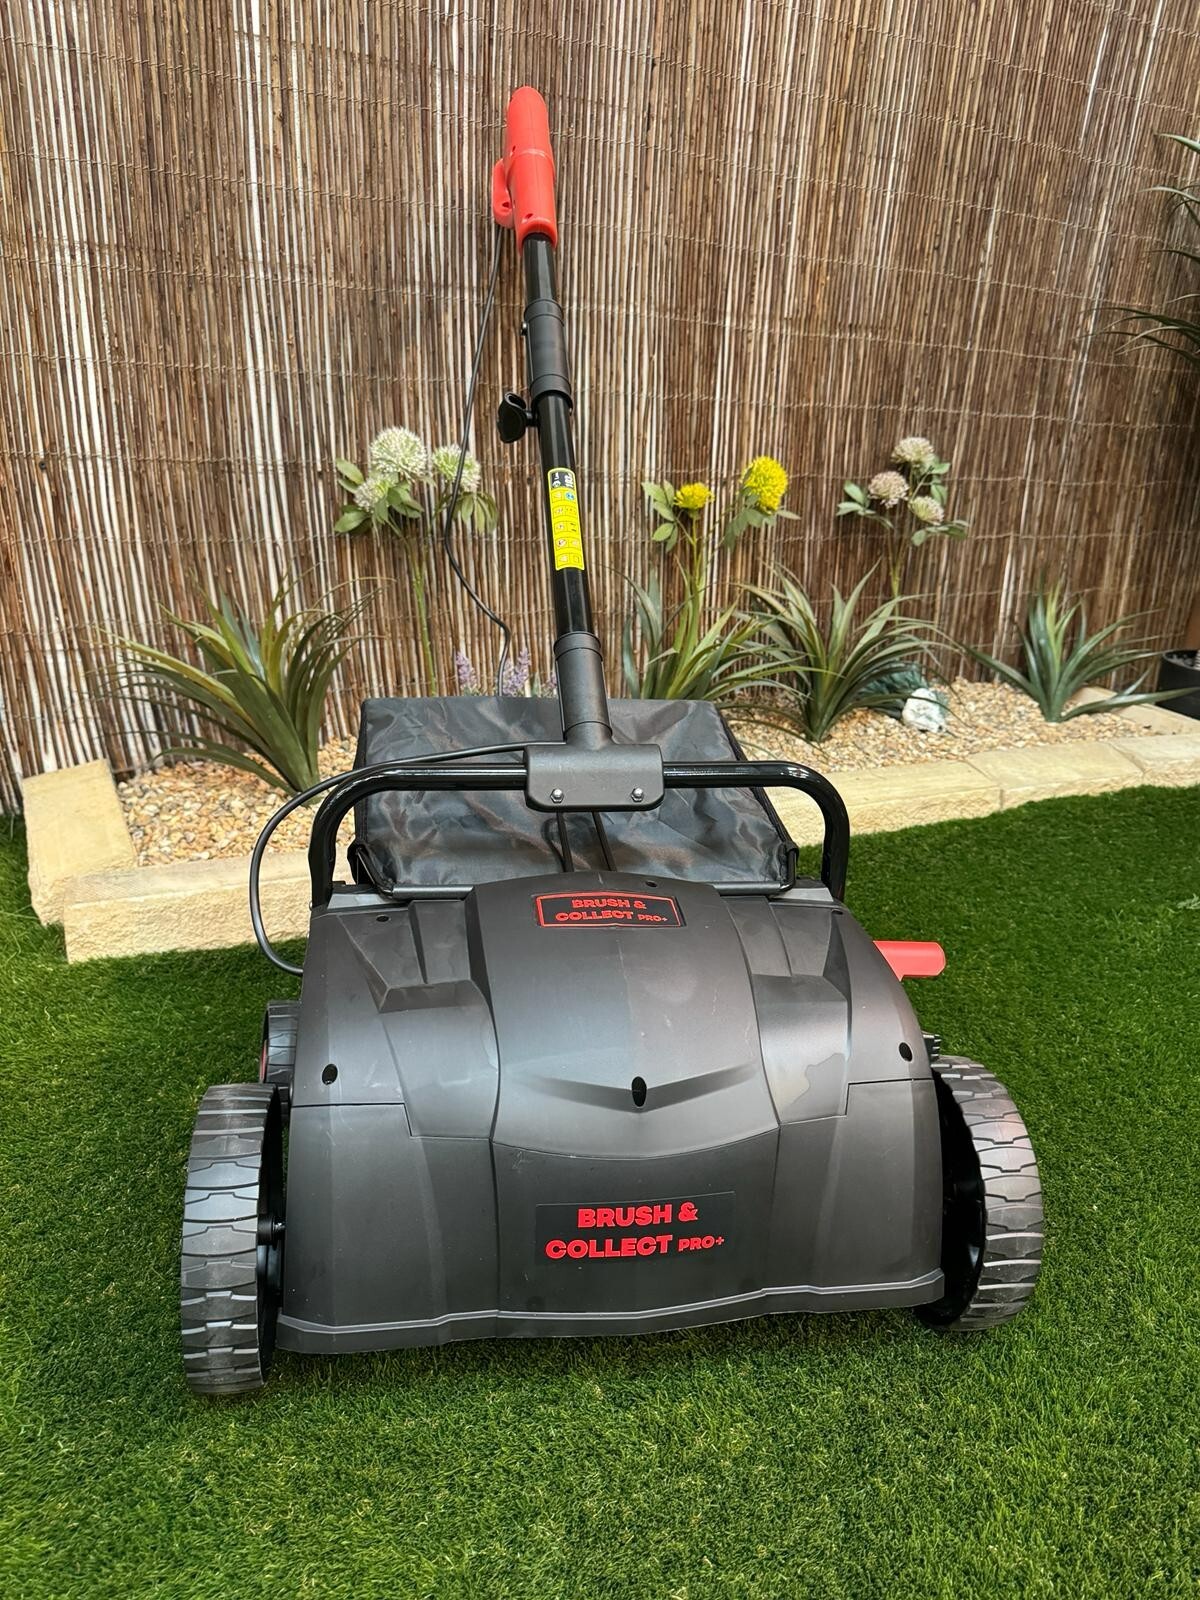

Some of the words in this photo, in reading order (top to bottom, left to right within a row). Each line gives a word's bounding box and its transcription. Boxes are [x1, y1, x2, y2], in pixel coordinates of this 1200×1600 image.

[571, 899, 630, 909] BRUSH
[633, 900, 647, 909] &
[555, 910, 634, 921] COLLECT
[637, 914, 668, 922] PRO+
[577, 1204, 672, 1228] BRUSH
[678, 1202, 698, 1222] &
[545, 1234, 673, 1259] COLLECT
[678, 1235, 725, 1252] PRO+
